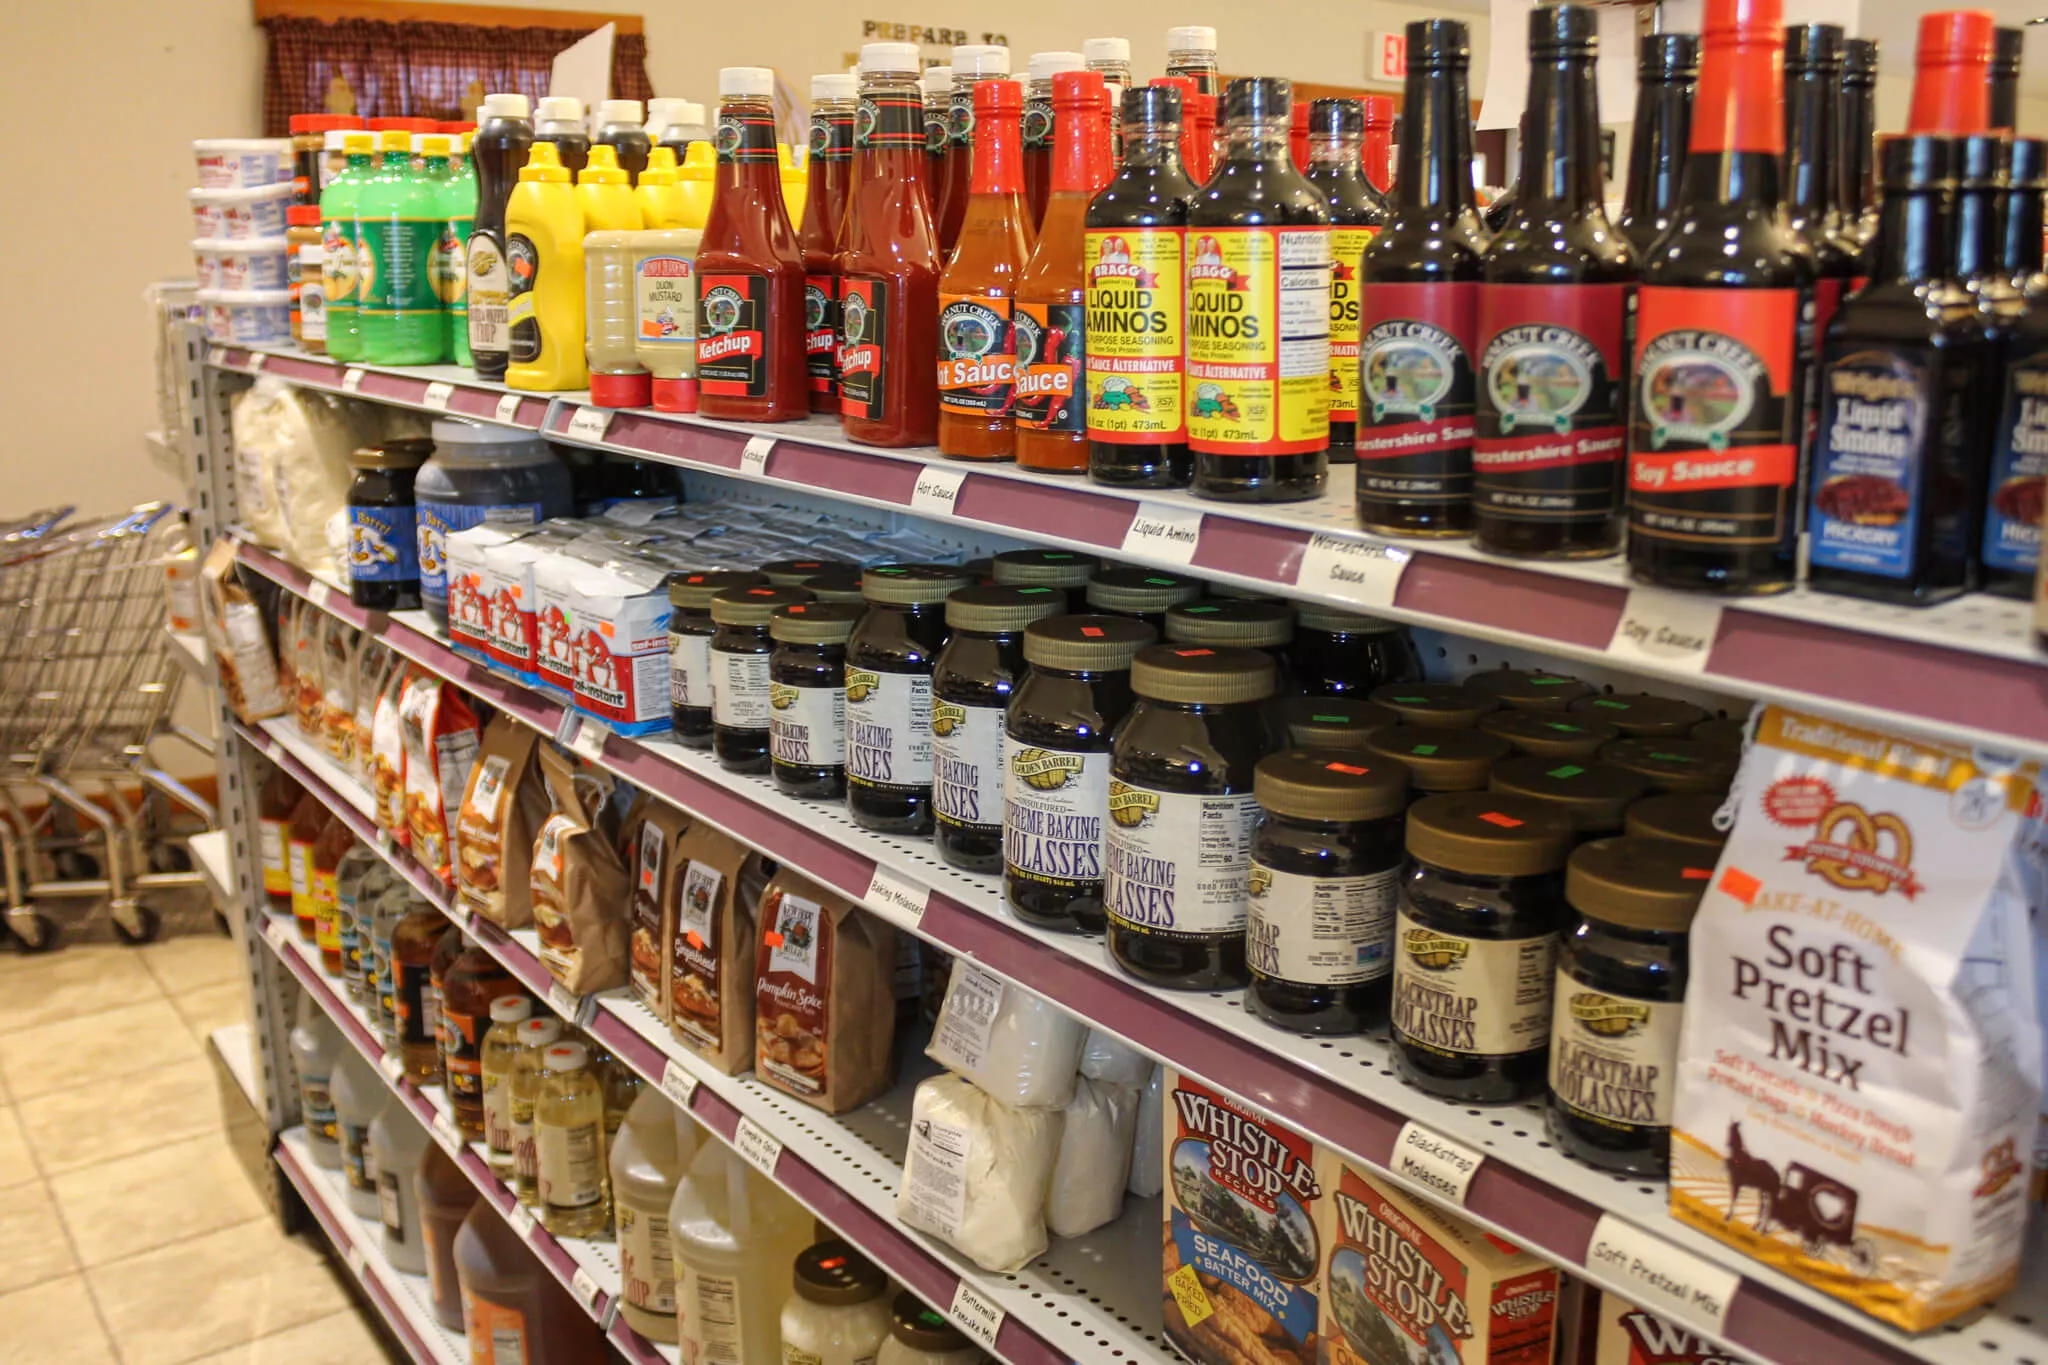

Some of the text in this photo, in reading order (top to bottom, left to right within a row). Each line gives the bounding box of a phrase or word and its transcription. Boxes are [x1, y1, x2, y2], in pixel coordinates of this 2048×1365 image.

[862, 19, 967, 45] PREPARE
[1094, 263, 1141, 277] BRAGG
[1089, 290, 1153, 310] LIQUID
[1086, 311, 1168, 334] AMINOS
[699, 335, 751, 360] Ketchup
[953, 361, 1016, 385] Sauc
[1133, 519, 1196, 544] Liquid Amino
[855, 722, 893, 750] BAKING
[1780, 714, 1886, 762] Traditional
[849, 748, 893, 782] ASSES
[942, 757, 979, 788] BAKING
[1014, 756, 1079, 774] GOLDEN BARREL
[1202, 802, 1234, 810] Nutrition
[1202, 811, 1223, 819] Facts
[1047, 812, 1101, 841] BAKING
[1127, 851, 1176, 888] BAKING
[871, 879, 924, 916] Baking Molasses
[1745, 893, 1903, 960] AKE-AT-HOME
[1766, 923, 1874, 992] Soft
[757, 975, 823, 1011] Pumpkin Spice
[1730, 955, 1912, 1058] Pretzel
[1767, 1017, 1864, 1092] Mix
[1175, 1090, 1316, 1199] WHISTLE
[1405, 1129, 1474, 1175] Blackstrap
[1210, 1139, 1283, 1195] STOP
[1401, 1153, 1458, 1197] Molasses
[1213, 1168, 1276, 1210] RECIPES
[1193, 1233, 1289, 1308] SEAFOOD
[1335, 1193, 1468, 1336] WHISTLE
[1593, 1240, 1722, 1317] Soft Pretzel Mix
[1175, 1274, 1205, 1304] BAKED
[1204, 1258, 1277, 1313] BATTER MIX
[1367, 1253, 1434, 1327] STOP
[961, 1288, 998, 1325] Buttermilk
[1368, 1284, 1427, 1342] RECIPES
